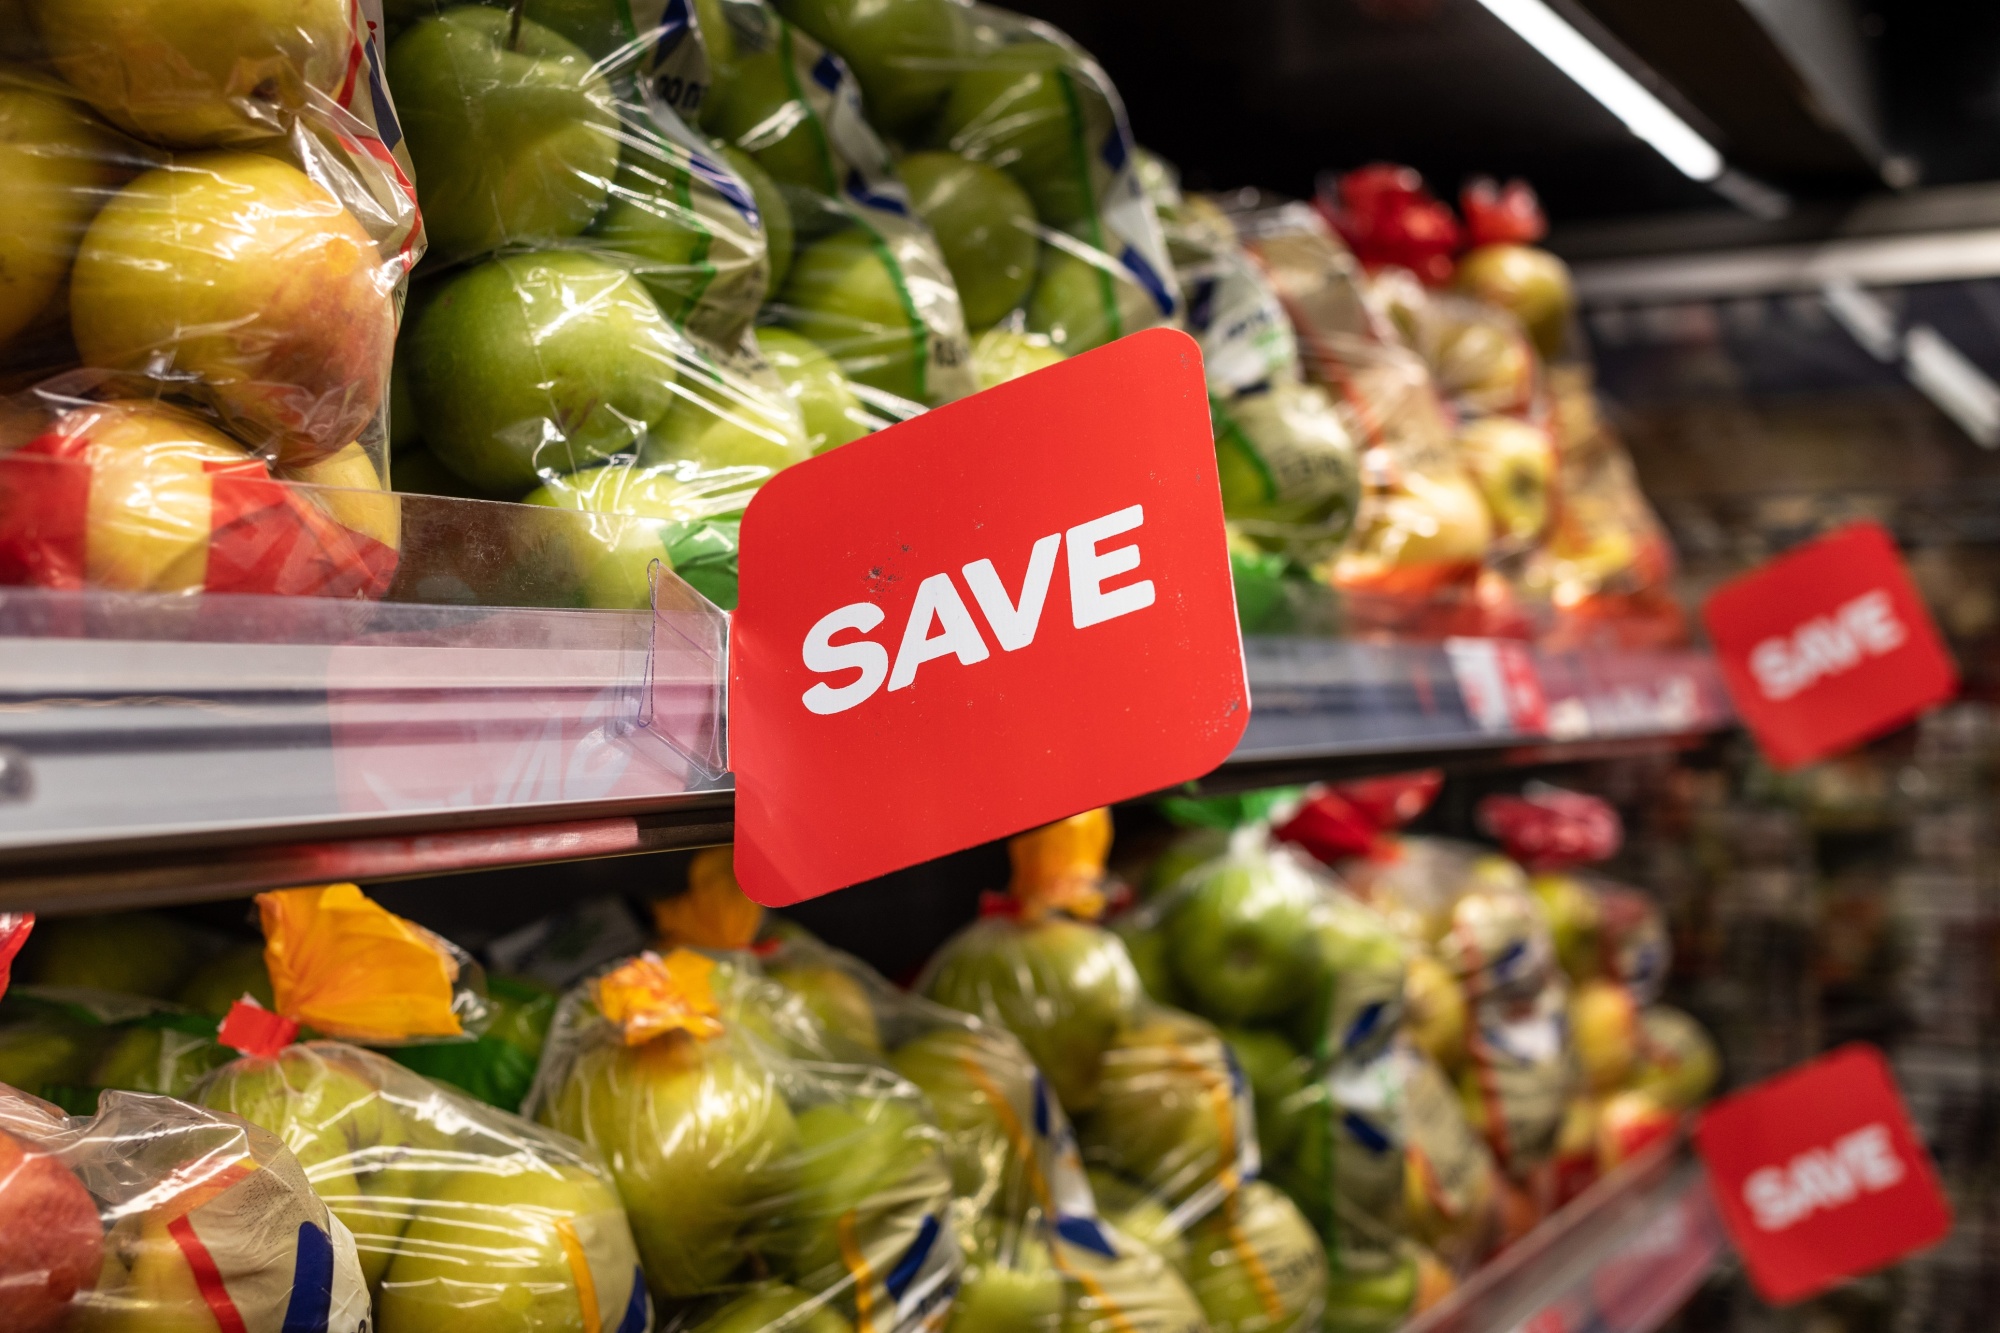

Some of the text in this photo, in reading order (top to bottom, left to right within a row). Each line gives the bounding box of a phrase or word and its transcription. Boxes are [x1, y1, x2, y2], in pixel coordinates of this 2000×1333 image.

[801, 503, 1157, 716] SAVE
[1750, 590, 1905, 699] SAVE
[1745, 1125, 1901, 1229] SAVE
